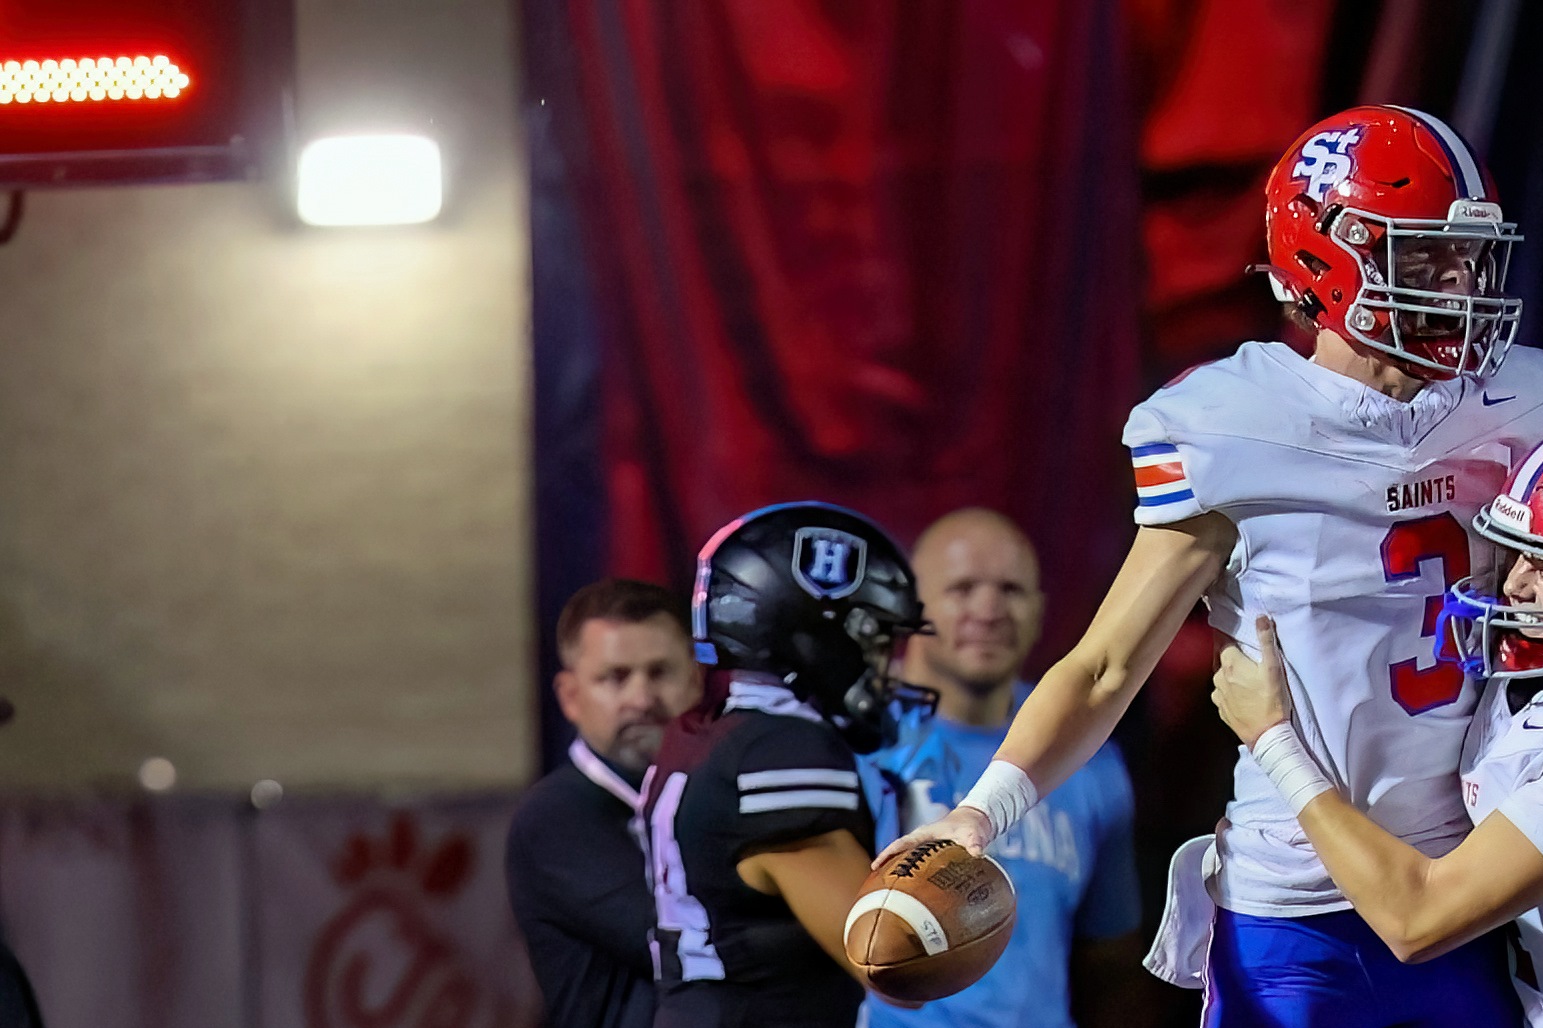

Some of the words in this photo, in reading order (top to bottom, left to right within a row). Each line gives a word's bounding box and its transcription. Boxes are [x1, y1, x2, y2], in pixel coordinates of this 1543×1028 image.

[1386, 475, 1456, 512] SAINTS
[811, 540, 850, 583] H
[1380, 511, 1470, 717] 3
